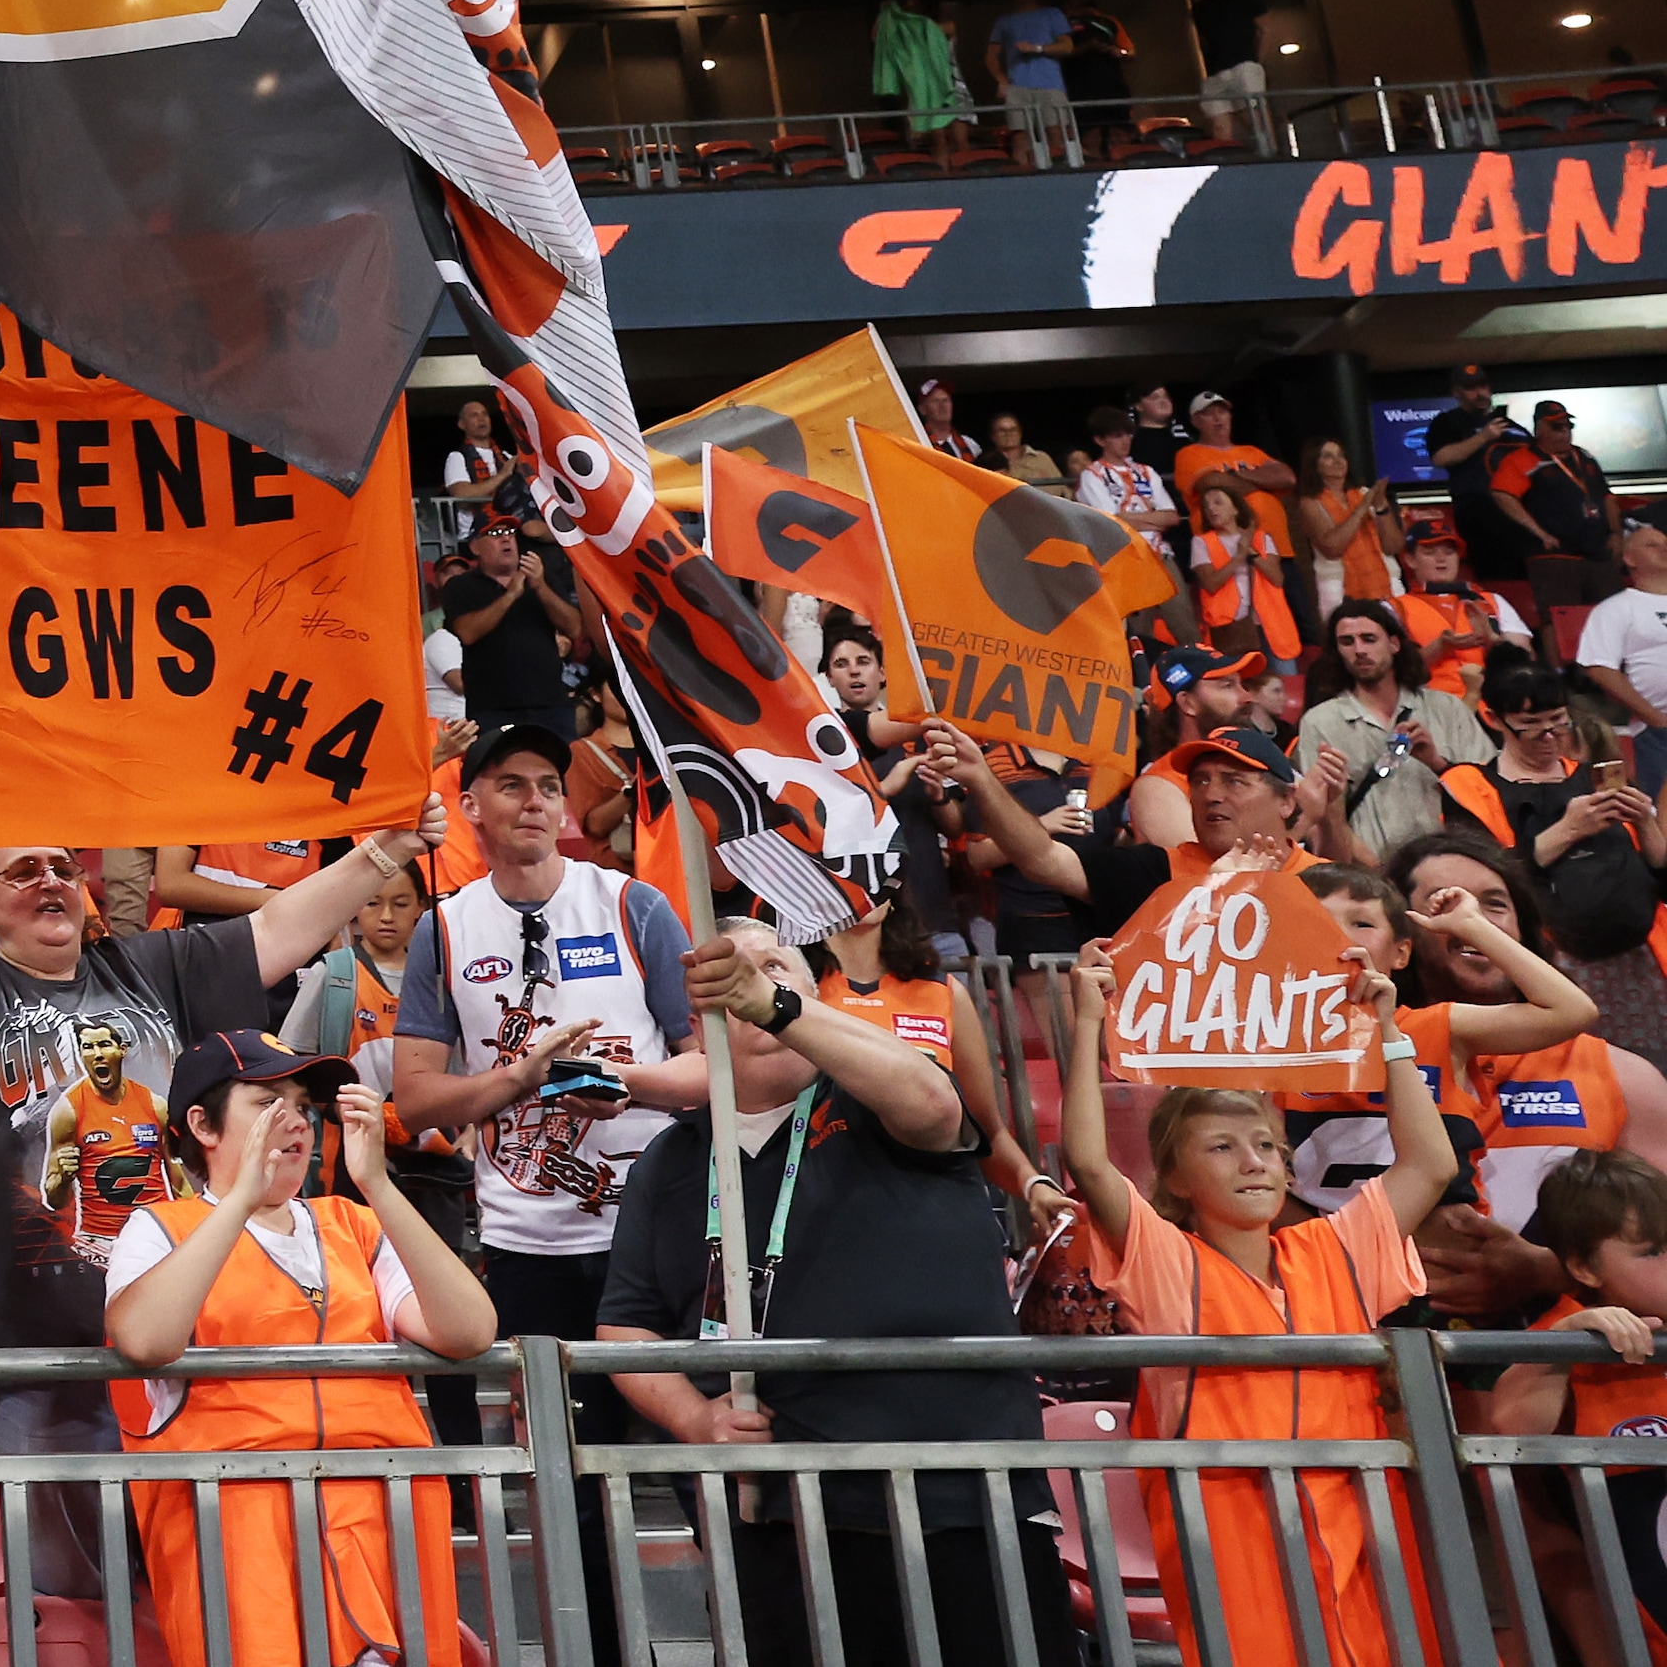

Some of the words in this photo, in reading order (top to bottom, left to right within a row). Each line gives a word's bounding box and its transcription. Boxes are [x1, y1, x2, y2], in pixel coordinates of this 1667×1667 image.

[9, 585, 216, 700] GWS
[912, 622, 1010, 659] GREATER
[1016, 642, 1122, 683] WESTERN
[916, 646, 1134, 756] GIANT
[225, 670, 385, 806] #4
[1164, 882, 1271, 975] GO
[560, 945, 604, 959] TOYO
[569, 953, 617, 969] TIRES
[465, 961, 510, 982] AFL
[1117, 957, 1352, 1057] GIANTS
[896, 1016, 945, 1032] Harvey
[895, 1027, 949, 1046] Norman
[1499, 1090, 1561, 1107] TOYO
[1511, 1101, 1581, 1116] TIRES
[84, 1132, 110, 1143] AFL
